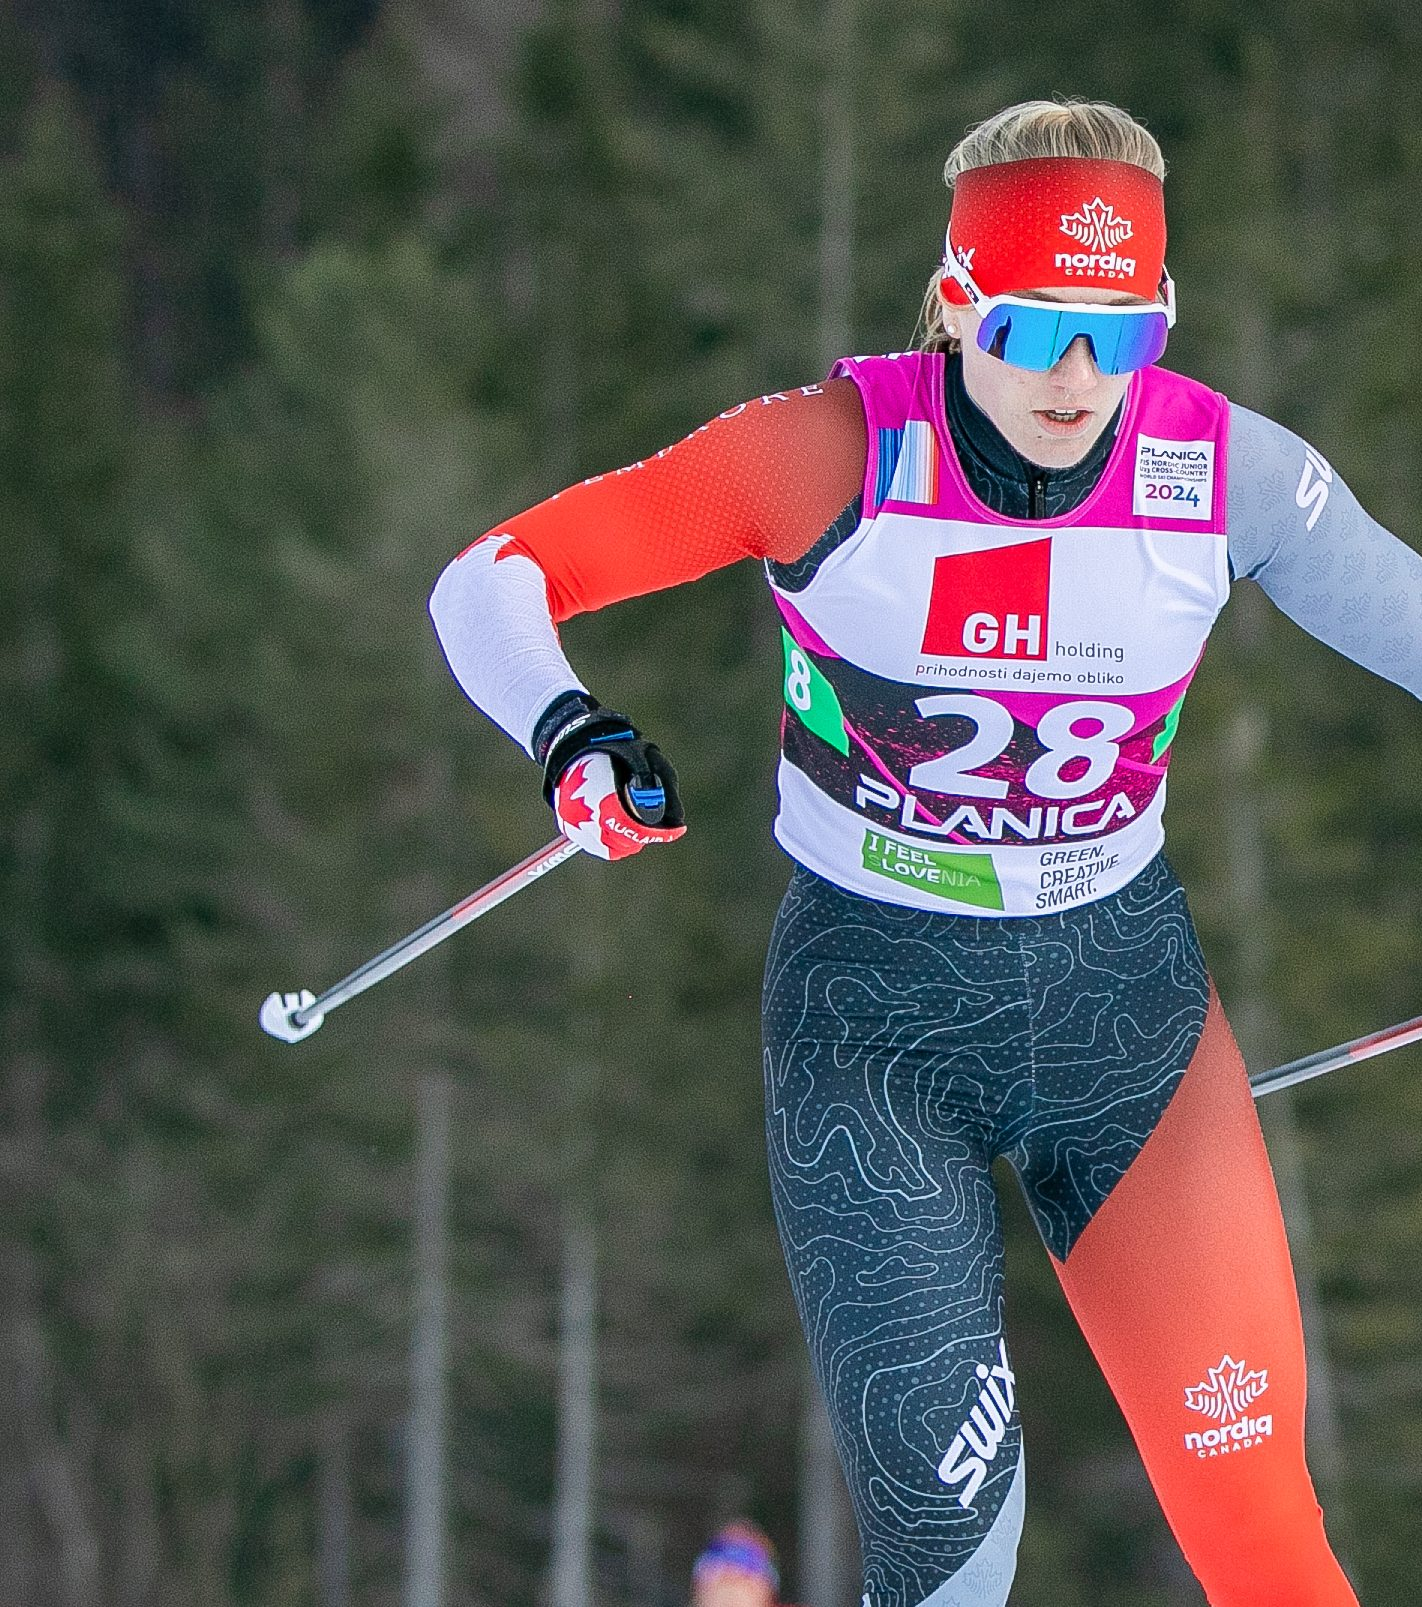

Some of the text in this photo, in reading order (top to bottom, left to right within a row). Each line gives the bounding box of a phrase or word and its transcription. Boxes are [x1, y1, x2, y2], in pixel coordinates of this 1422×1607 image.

[1054, 251, 1136, 277] nordiq
[1065, 268, 1126, 280] CANADA
[1140, 446, 1208, 461] PLANICA
[1151, 460, 1180, 468] NORDIC
[1145, 484, 1201, 507] 2024
[962, 611, 1124, 662] GH holding
[915, 663, 1124, 684] prihodnosti dajemo obliko
[908, 693, 1135, 800] 28
[856, 773, 1137, 840] PLANICA
[869, 834, 937, 867] I FEEL
[1040, 844, 1105, 866] GREEN.
[868, 854, 982, 887] SLOVENIA
[1035, 878, 1097, 909] SMART.
[1184, 1414, 1272, 1450] nordiq
[1197, 1435, 1263, 1459] CANADA
